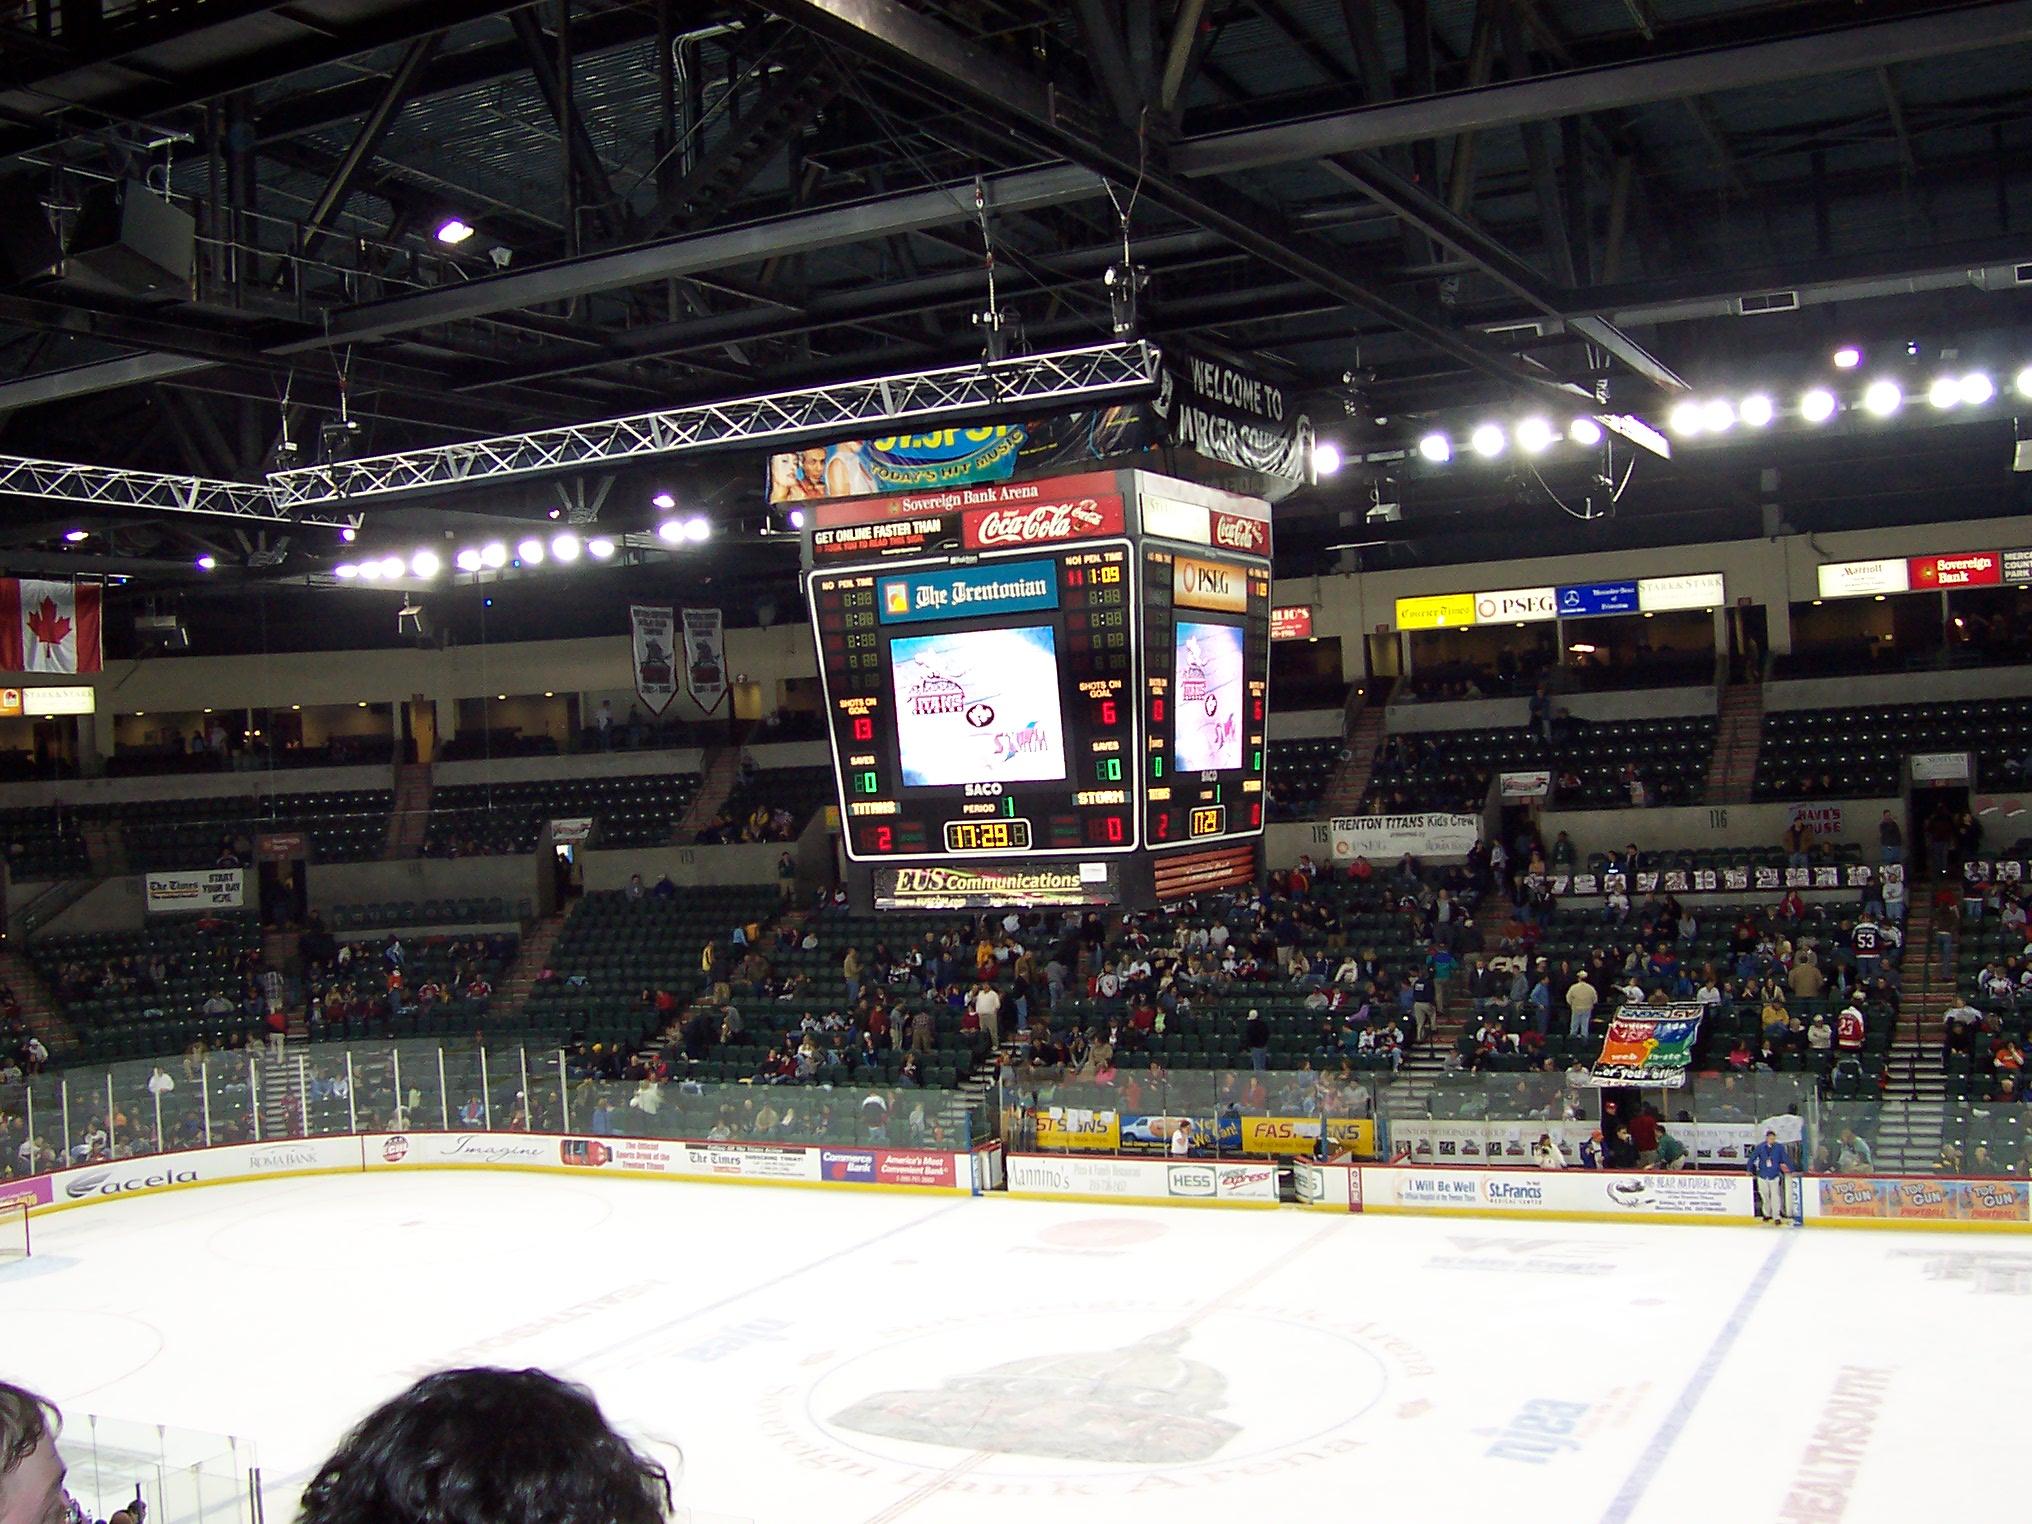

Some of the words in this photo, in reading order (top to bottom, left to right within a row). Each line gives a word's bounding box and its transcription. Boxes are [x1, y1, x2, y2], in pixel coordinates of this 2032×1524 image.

[1190, 356, 1263, 416] WELCOME
[1264, 384, 1284, 421] TO
[872, 464, 936, 483] TODAY'S
[940, 464, 972, 479] HIT
[975, 428, 1025, 467] MUSIC
[902, 492, 962, 513] Sovereign
[963, 487, 997, 505] Bank
[999, 484, 1039, 500] Arena
[814, 530, 834, 545] GET
[835, 526, 873, 542] ONLINE
[873, 520, 912, 539] FASTER
[912, 517, 942, 535] THAN
[978, 502, 1074, 545] Coca-Cola
[1216, 514, 1253, 549] Coca-Cola
[1937, 556, 1992, 571] Sovereign
[1067, 569, 1084, 587] 11
[1090, 565, 1121, 585] 1:09
[1198, 566, 1231, 595] PSEG
[1938, 571, 1969, 584] Bank
[915, 585, 949, 610] The
[951, 579, 1047, 606] Trentonian
[1400, 606, 1439, 619] Courier
[1440, 603, 1471, 617] Times
[1502, 596, 1553, 614] PSEG
[1079, 680, 1107, 691] SHOTS
[1108, 679, 1122, 689] ON
[1089, 689, 1113, 698] GOAL
[839, 698, 865, 709] SHOTS
[865, 697, 878, 706] ON
[847, 706, 870, 715] GOAL
[1101, 701, 1117, 725] 6
[1107, 757, 1122, 781] 0
[863, 771, 878, 793] 0
[964, 782, 1003, 797] SACO
[1077, 789, 1125, 805] STORM
[851, 801, 897, 816] TITANS
[962, 803, 996, 814] PERIOD
[1331, 817, 1382, 832] TRENTON
[1386, 815, 1424, 830] TITANS
[1427, 815, 1448, 828] Kids
[1450, 814, 1475, 827] Crew
[1709, 808, 1728, 829] 116
[1106, 815, 1122, 842] 0
[1312, 825, 1329, 844] 115
[877, 825, 892, 851] 2
[150, 880, 168, 892] The
[168, 879, 199, 891] Times
[894, 867, 946, 892] EUS
[947, 872, 1081, 890] Communications
[1857, 933, 1876, 948] 53
[440, 1134, 545, 1162] Imagine
[249, 1154, 283, 1169] ROMA
[284, 1151, 318, 1165] BANK
[689, 1151, 708, 1164] The
[710, 1152, 741, 1165] Times
[822, 1151, 873, 1164] Commerce
[884, 1154, 922, 1166] America's
[922, 1156, 944, 1167] Most
[846, 1161, 871, 1173] Bank
[880, 1164, 924, 1175] Convenient
[100, 1168, 199, 1196] acela
[1173, 1174, 1211, 1188] HESS
[1223, 1171, 1271, 1187] express
[1415, 1180, 1435, 1191] Will
[1438, 1181, 1451, 1191] Be
[1453, 1181, 1475, 1192] Well
[1833, 1182, 1856, 1195] TOP
[1902, 1183, 1926, 1197] TOP
[1973, 1184, 1997, 1198] TOP
[1843, 1190, 1873, 1204] GUN
[1912, 1191, 1942, 1206] GUN
[1982, 1192, 2014, 1208] GUN
[1128, 1436, 1368, 1496] Arena
